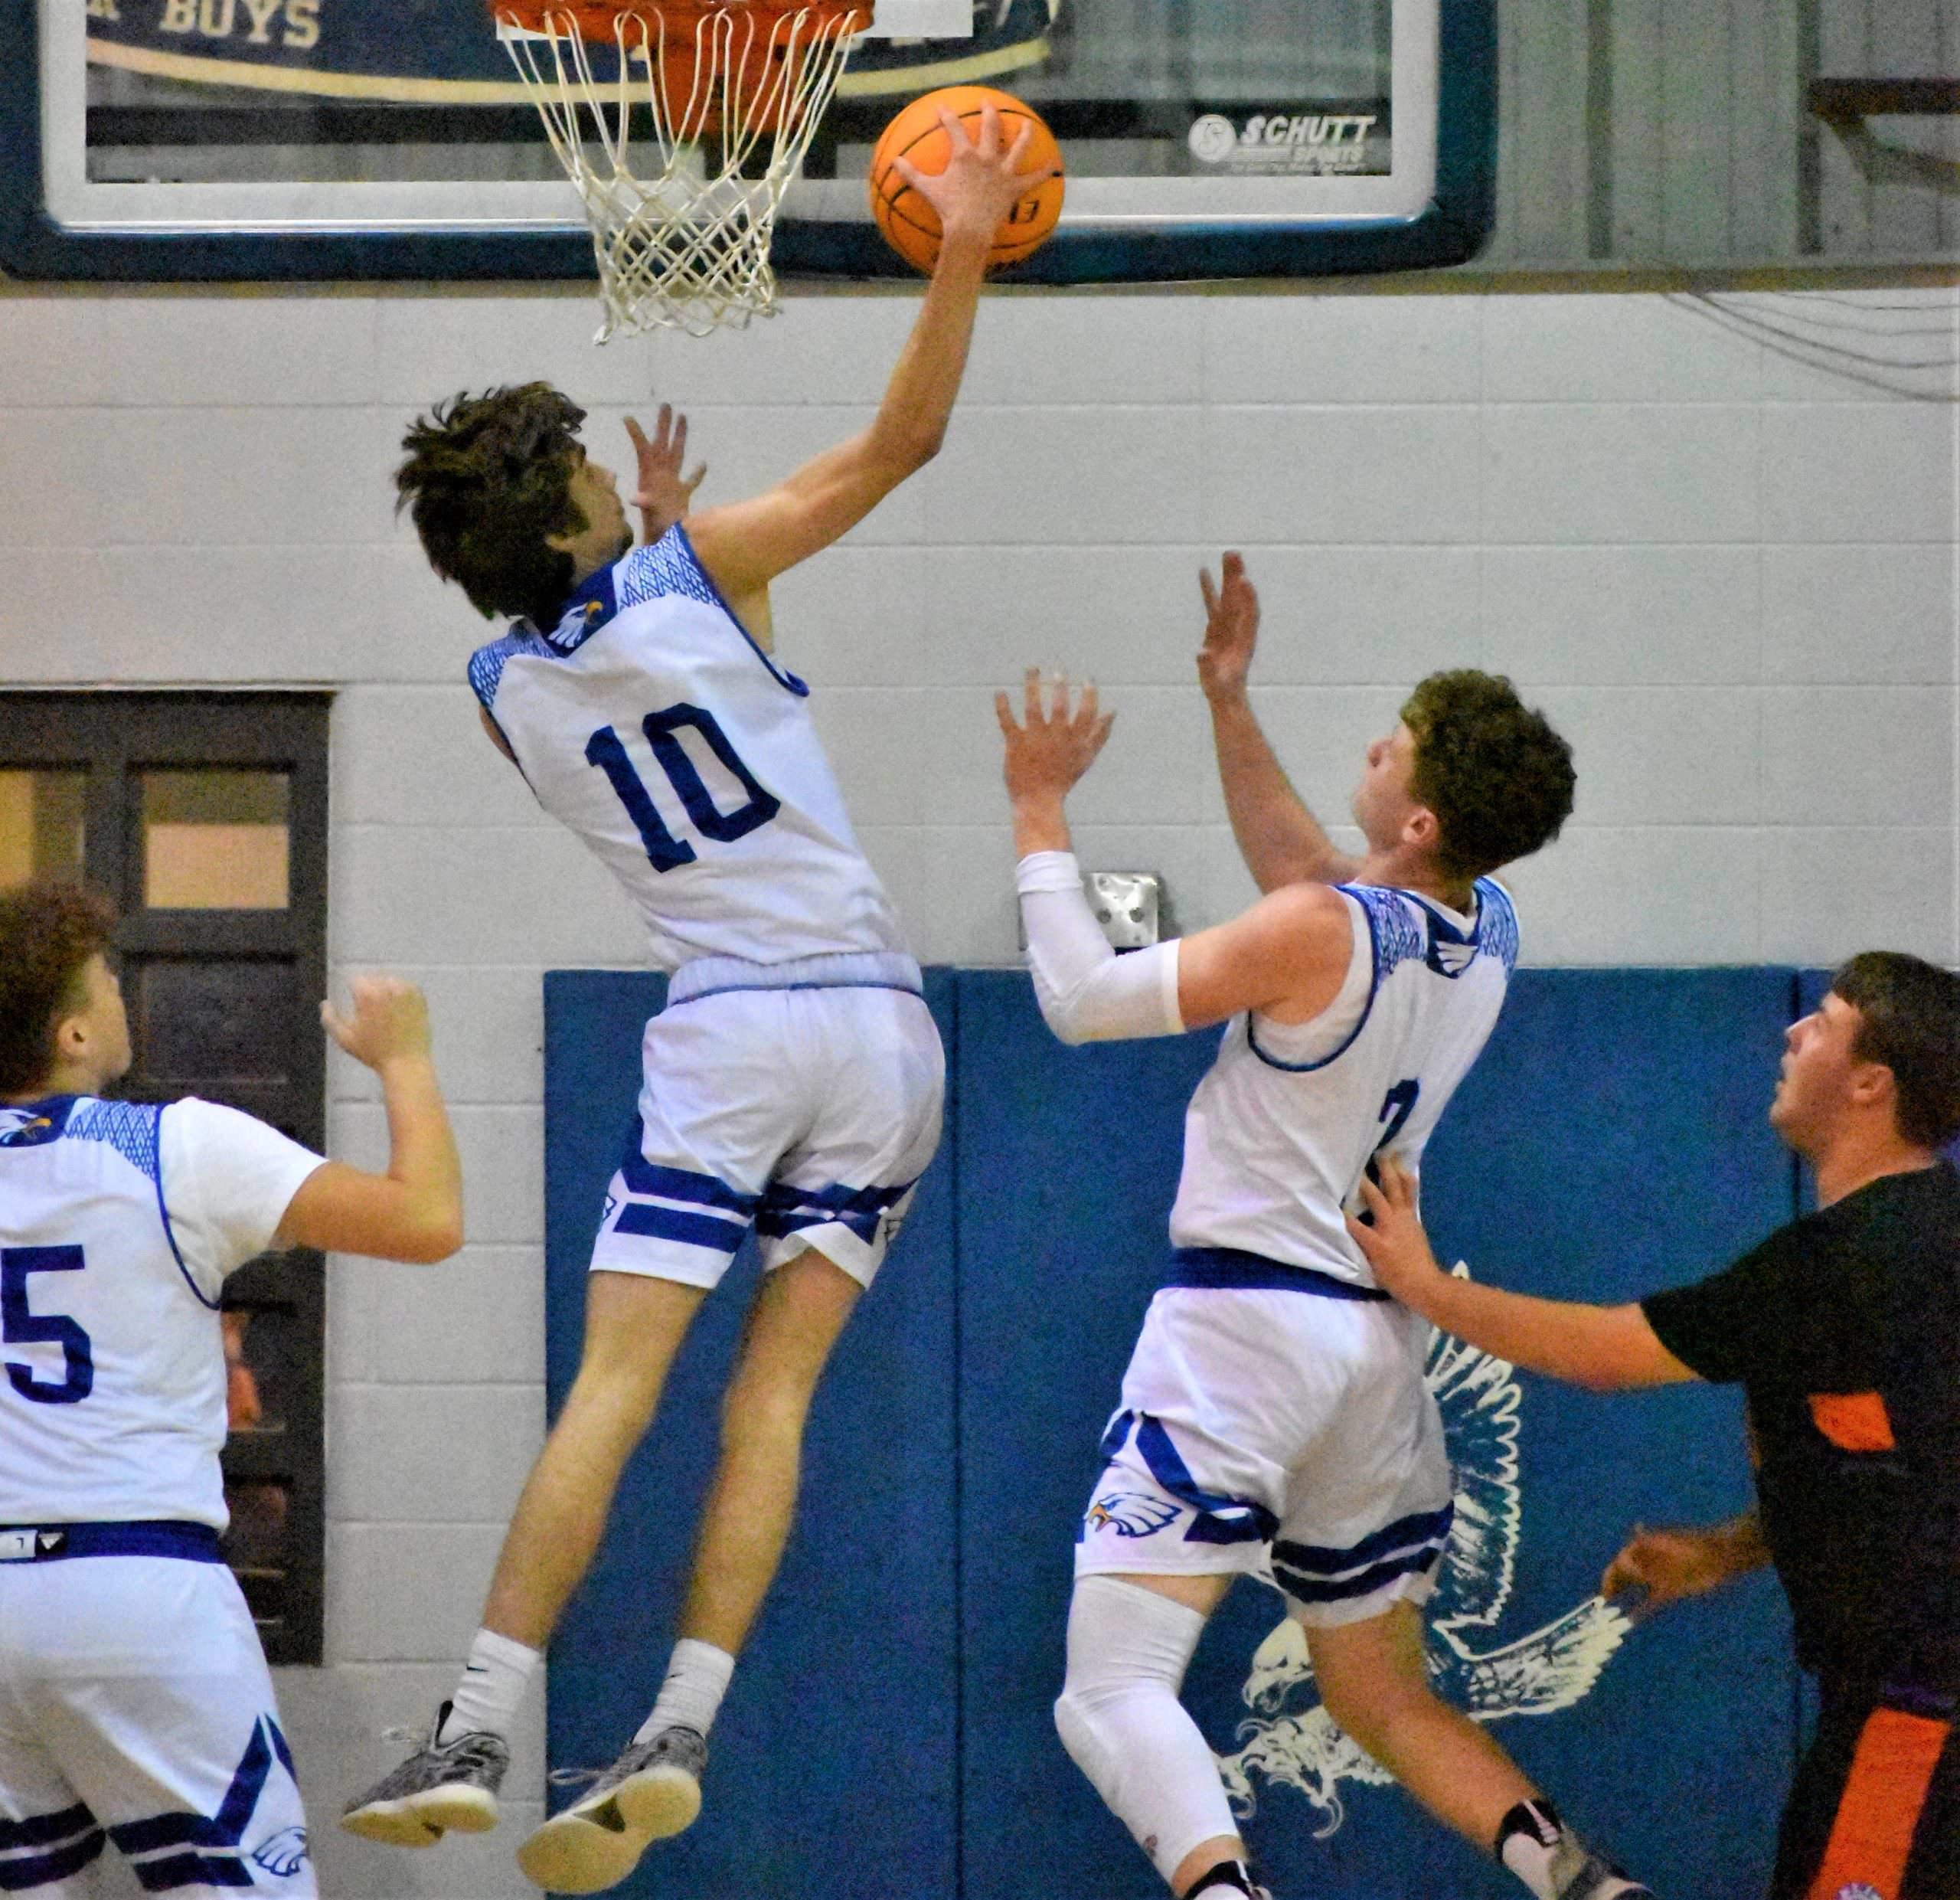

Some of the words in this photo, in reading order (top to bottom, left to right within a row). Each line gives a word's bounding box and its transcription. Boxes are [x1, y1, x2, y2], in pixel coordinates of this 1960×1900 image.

[159, 0, 320, 48] BOYS
[1240, 115, 1377, 143] SCHUTT
[584, 702, 781, 873] 10
[0, 1244, 94, 1404] 5
